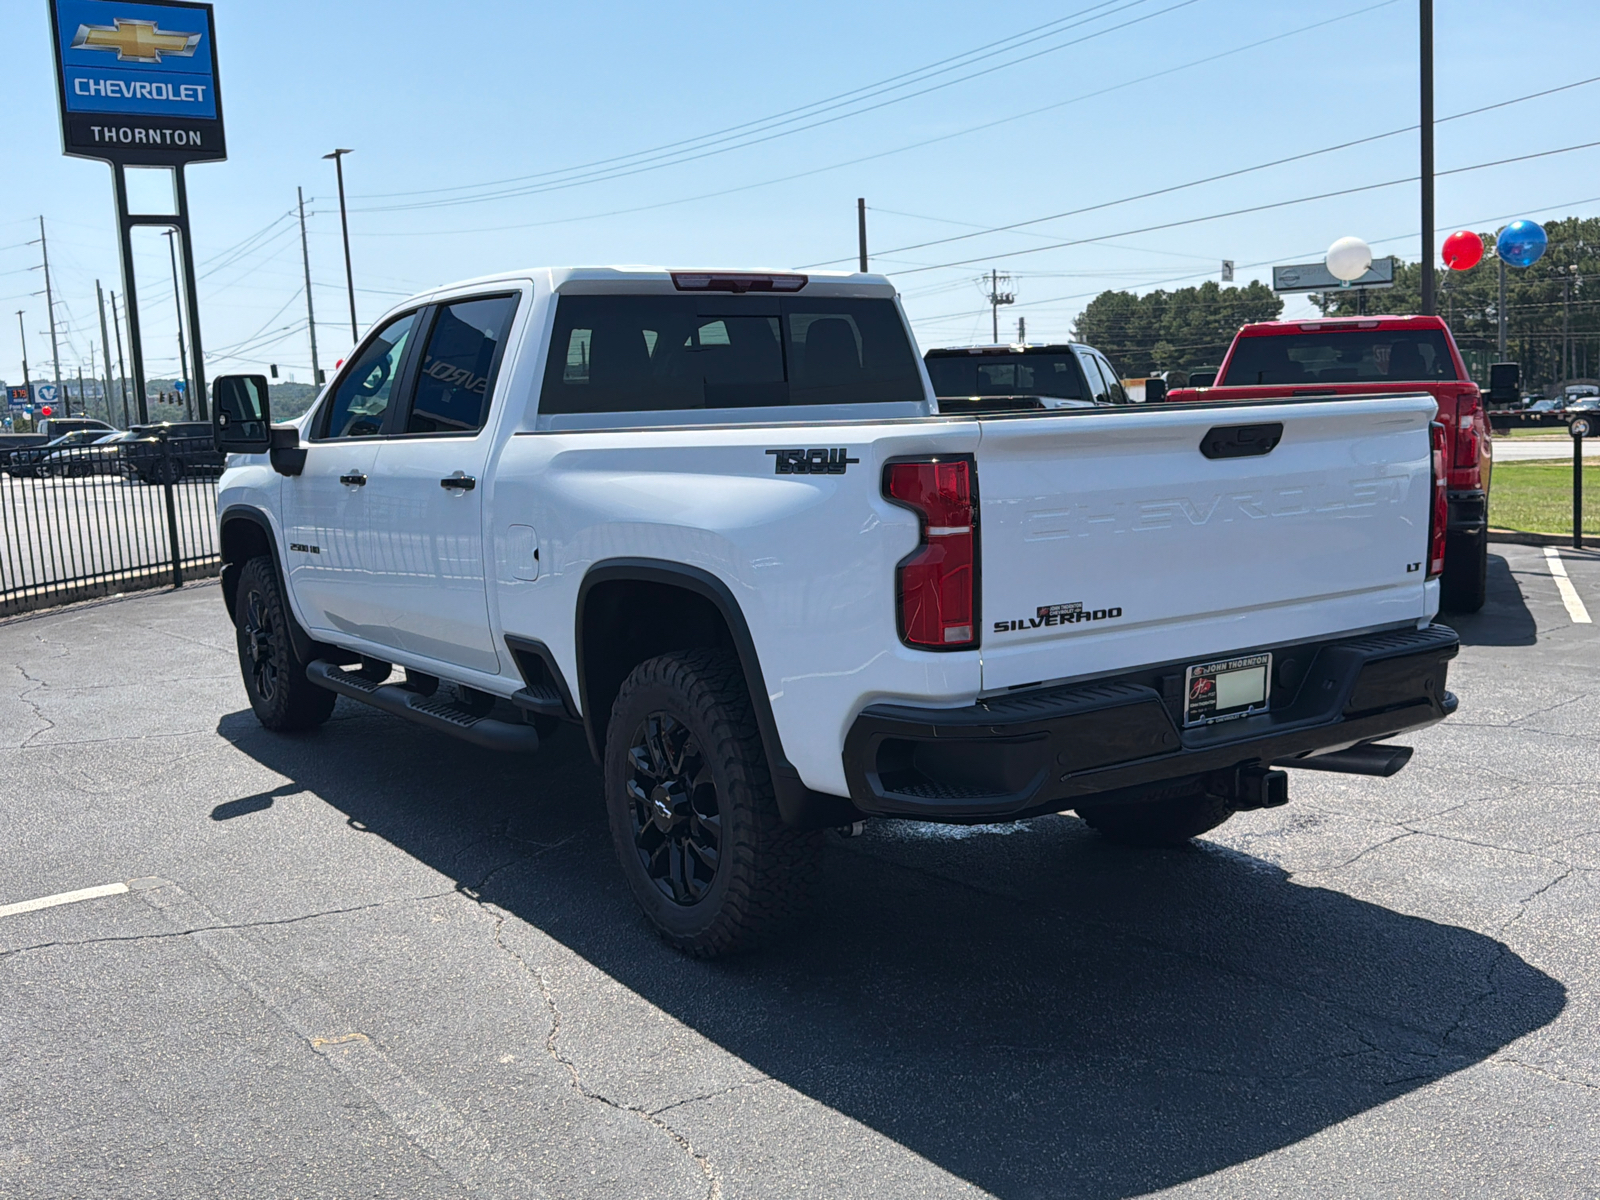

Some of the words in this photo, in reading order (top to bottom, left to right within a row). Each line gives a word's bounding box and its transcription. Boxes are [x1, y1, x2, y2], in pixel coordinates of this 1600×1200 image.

[74, 77, 207, 102] CHEVROLET
[90, 126, 202, 146] THORNTON
[1024, 474, 1409, 542] CHEVROLET
[1405, 560, 1423, 574] LT
[993, 606, 1123, 633] SILVERADO
[1207, 663, 1227, 673] JOHN
[1228, 656, 1267, 668] THORNTON
